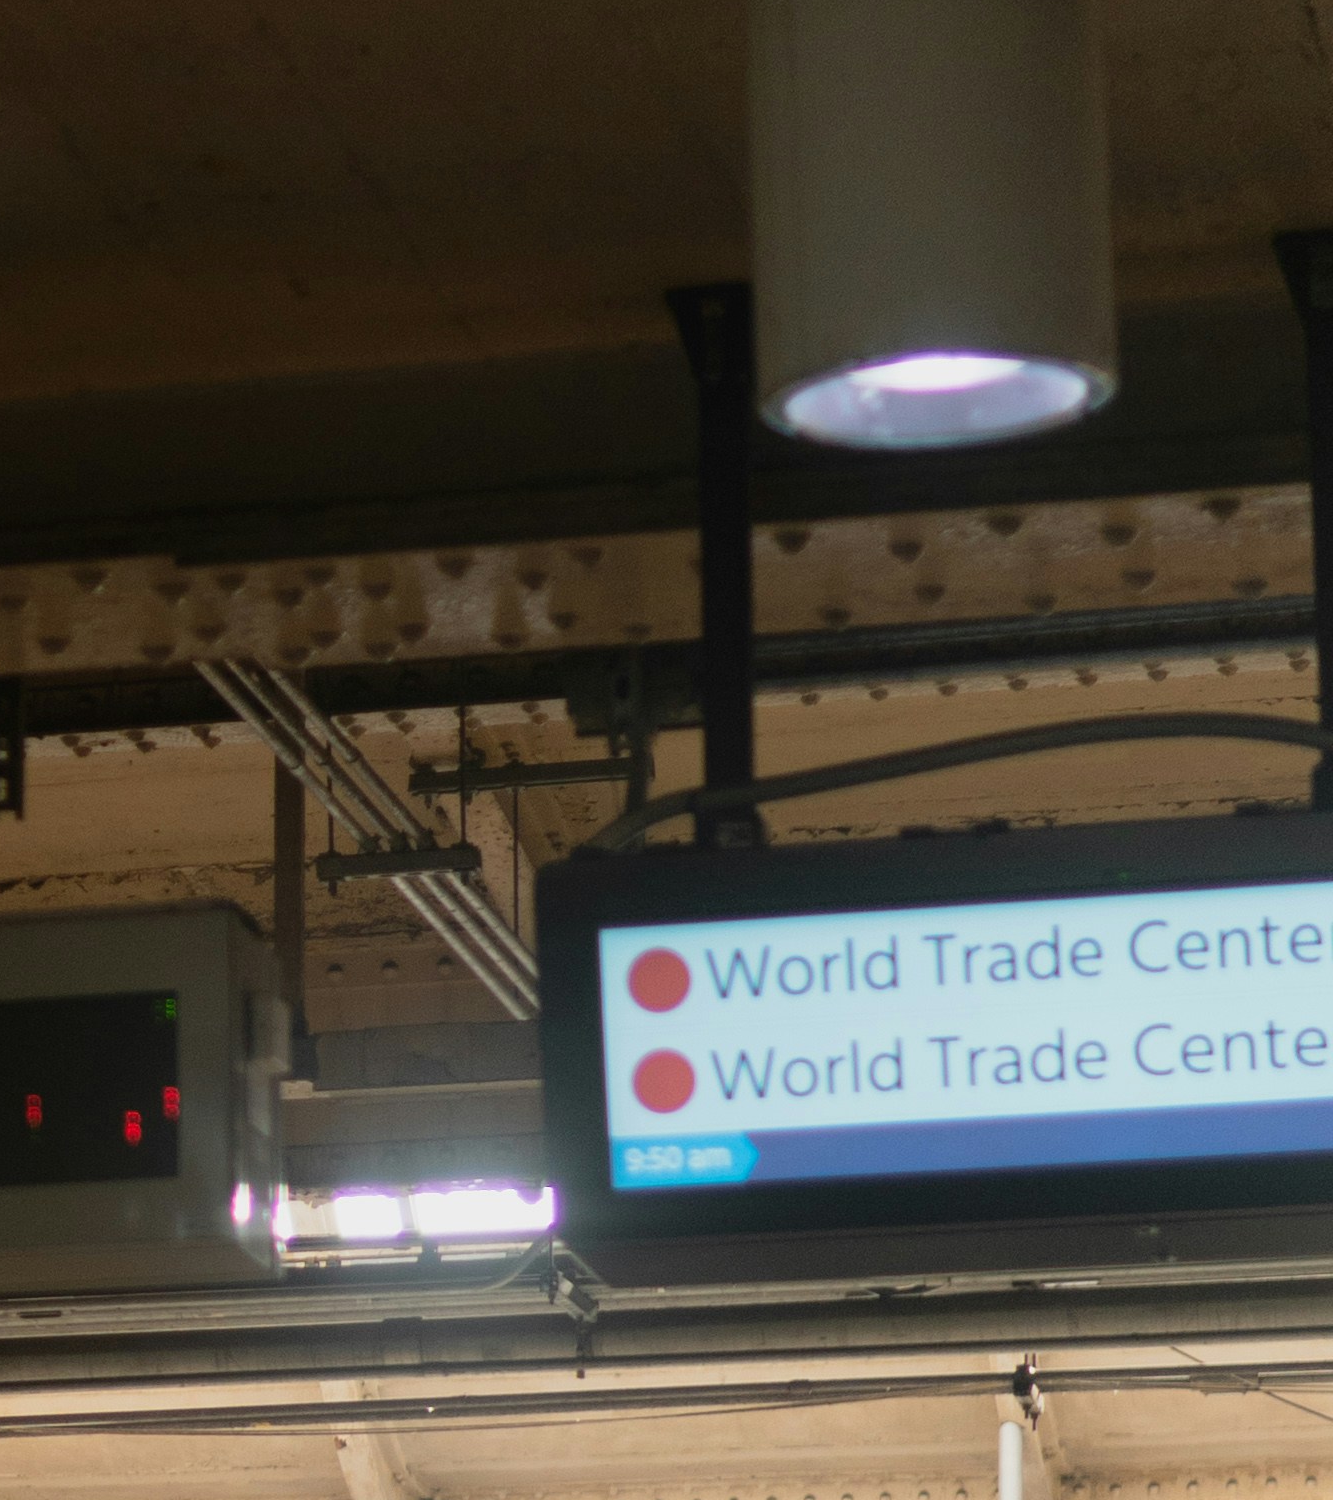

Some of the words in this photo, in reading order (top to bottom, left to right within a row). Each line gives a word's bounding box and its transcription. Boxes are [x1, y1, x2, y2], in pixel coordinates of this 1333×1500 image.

[705, 934, 899, 1000] World
[920, 924, 1103, 985] Trade
[1128, 915, 1333, 973] Cente
[711, 1037, 904, 1101] World
[926, 1027, 1108, 1088] Trade
[687, 1145, 733, 1171] am
